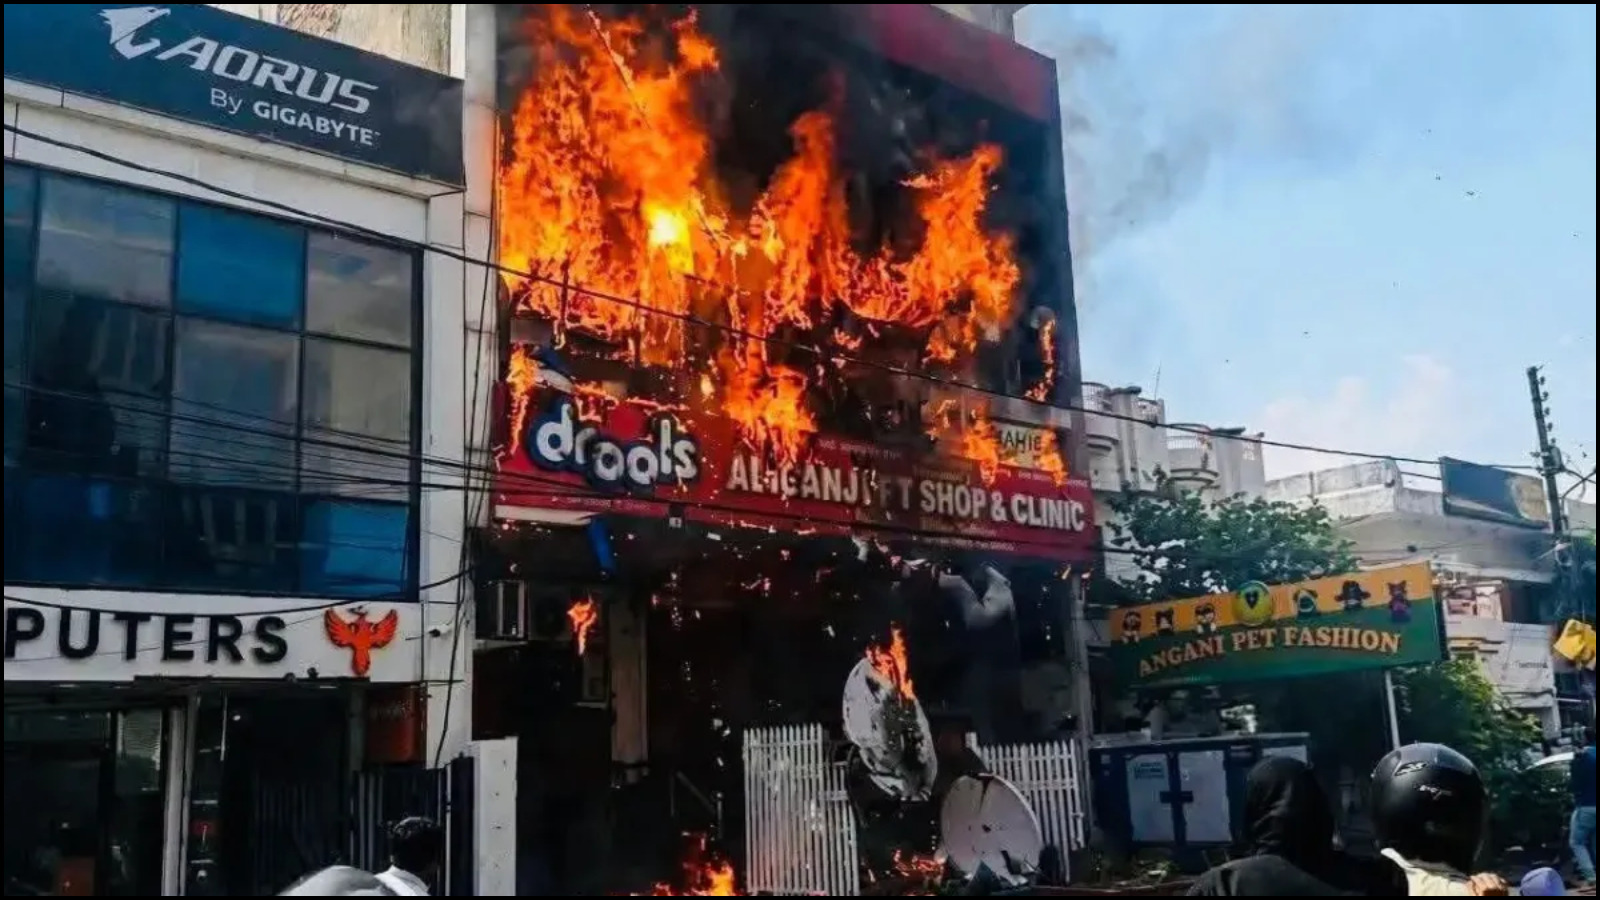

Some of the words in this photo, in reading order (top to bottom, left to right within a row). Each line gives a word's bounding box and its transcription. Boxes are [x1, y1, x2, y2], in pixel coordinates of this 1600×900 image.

[154, 36, 379, 115] AORUS
[210, 87, 243, 115] By
[253, 100, 374, 146] GIGABYTE
[536, 403, 698, 486] drools
[919, 479, 986, 519] SHOP
[990, 491, 1007, 522] &
[1010, 493, 1085, 533] CLINIC
[4, 607, 288, 663] PUTERS
[1138, 634, 1225, 678] ANGANI
[1231, 627, 1278, 652] PET
[1284, 626, 1401, 654] FASHION
